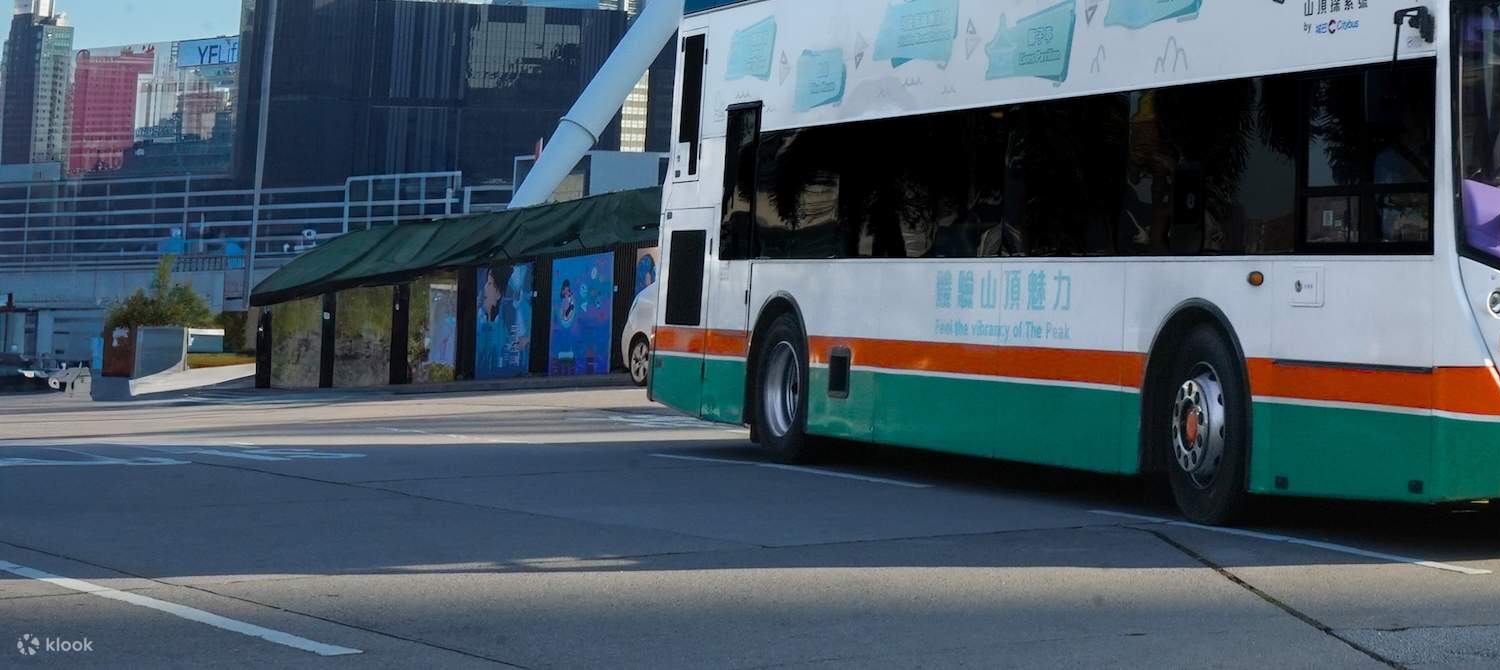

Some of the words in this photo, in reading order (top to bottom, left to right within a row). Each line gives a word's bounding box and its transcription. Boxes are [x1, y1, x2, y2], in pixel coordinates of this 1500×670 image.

[1303, 22, 1312, 33] by
[936, 319, 953, 335] Feel
[954, 320, 968, 336] the
[972, 320, 1009, 342] vibrancy
[1012, 321, 1022, 338] of
[1024, 321, 1041, 338] The
[1045, 322, 1070, 340] Peak
